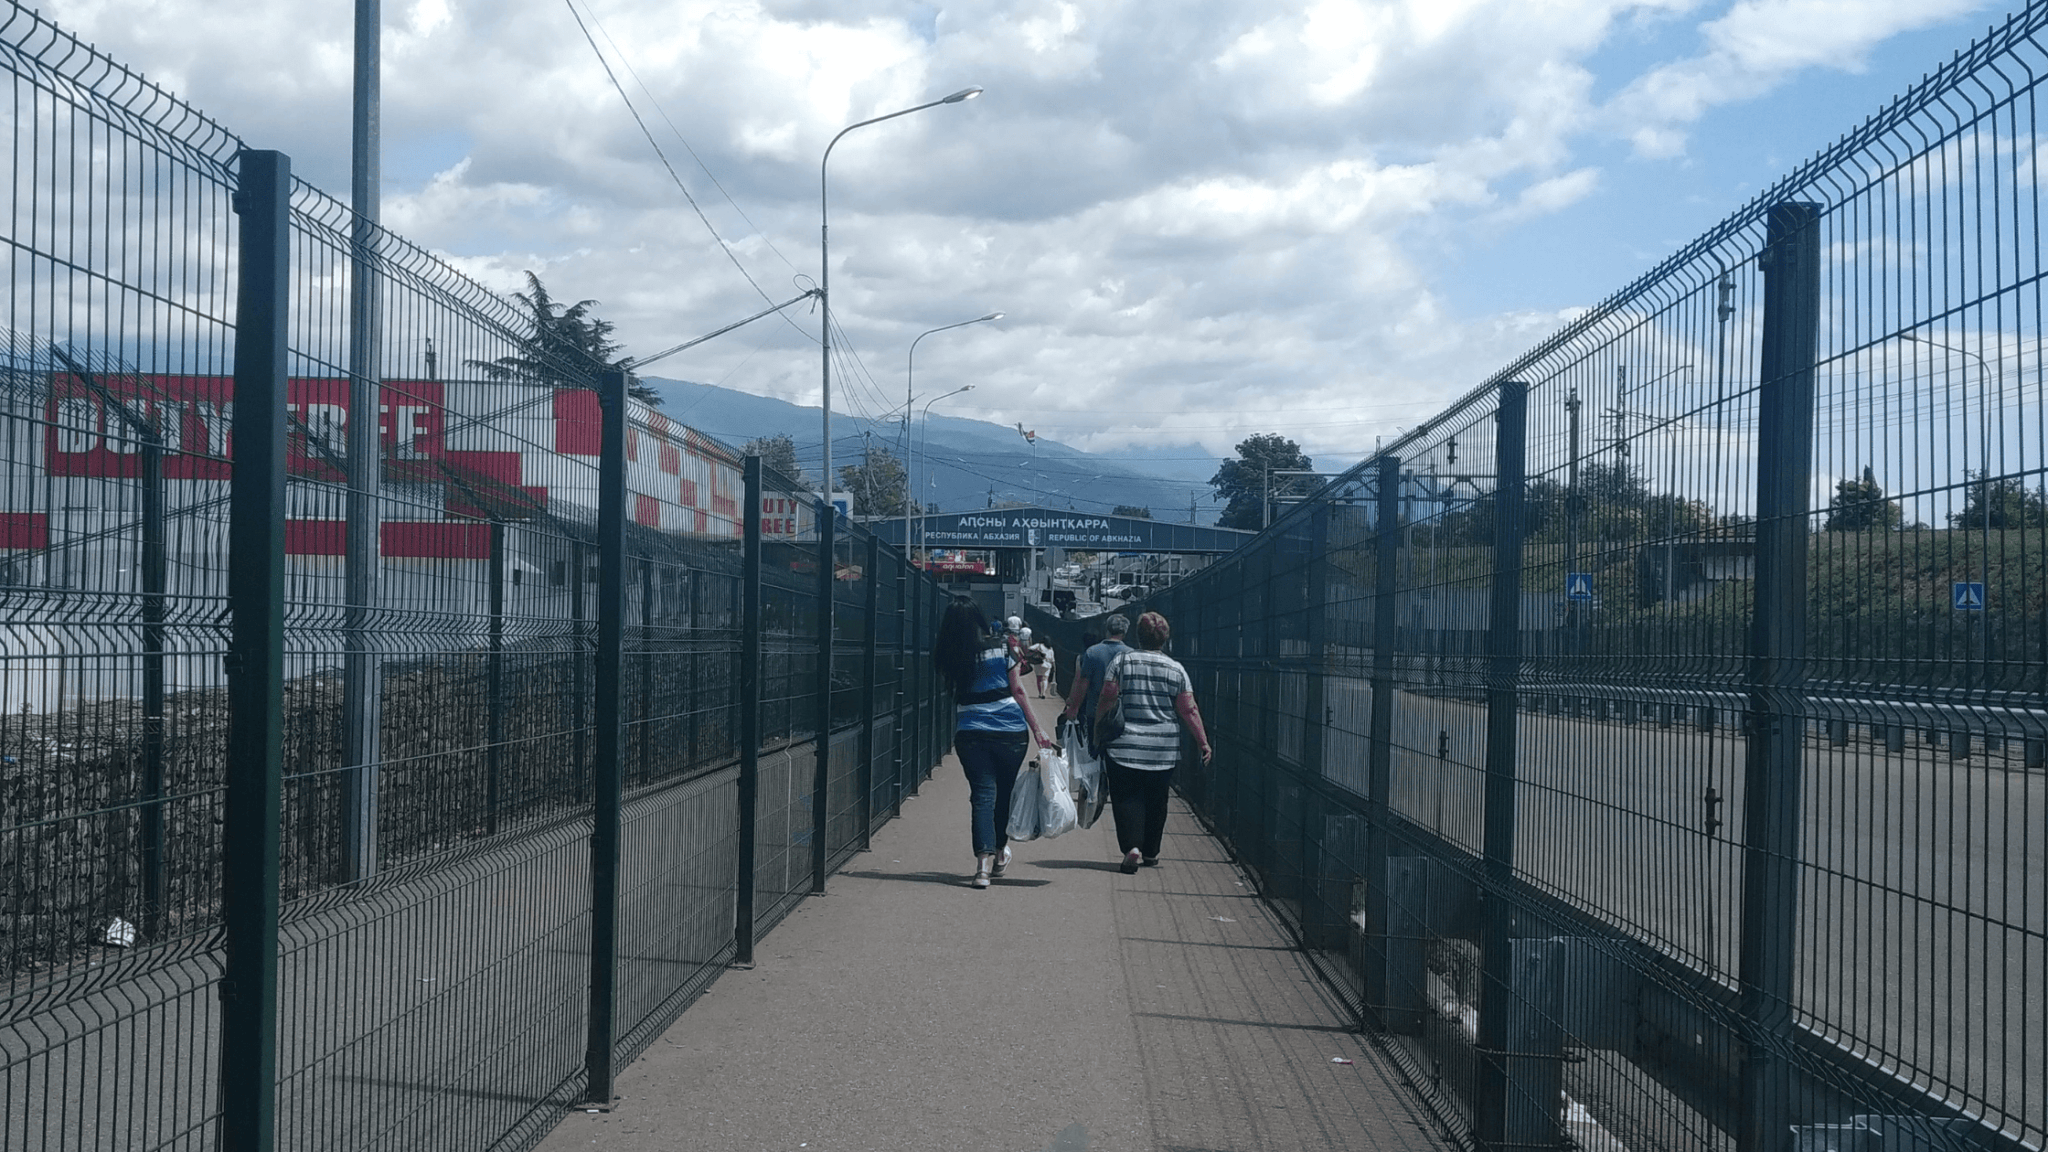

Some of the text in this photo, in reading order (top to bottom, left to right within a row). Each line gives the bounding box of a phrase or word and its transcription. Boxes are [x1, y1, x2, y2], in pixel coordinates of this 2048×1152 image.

[763, 498, 797, 514] UTY
[762, 518, 795, 534] REE
[925, 531, 1020, 541] РЕСПУБЛИКА АБХАЗИЯ
[1048, 533, 1087, 542] REPUBLIC
[1101, 535, 1142, 543] ABKHAZIA
